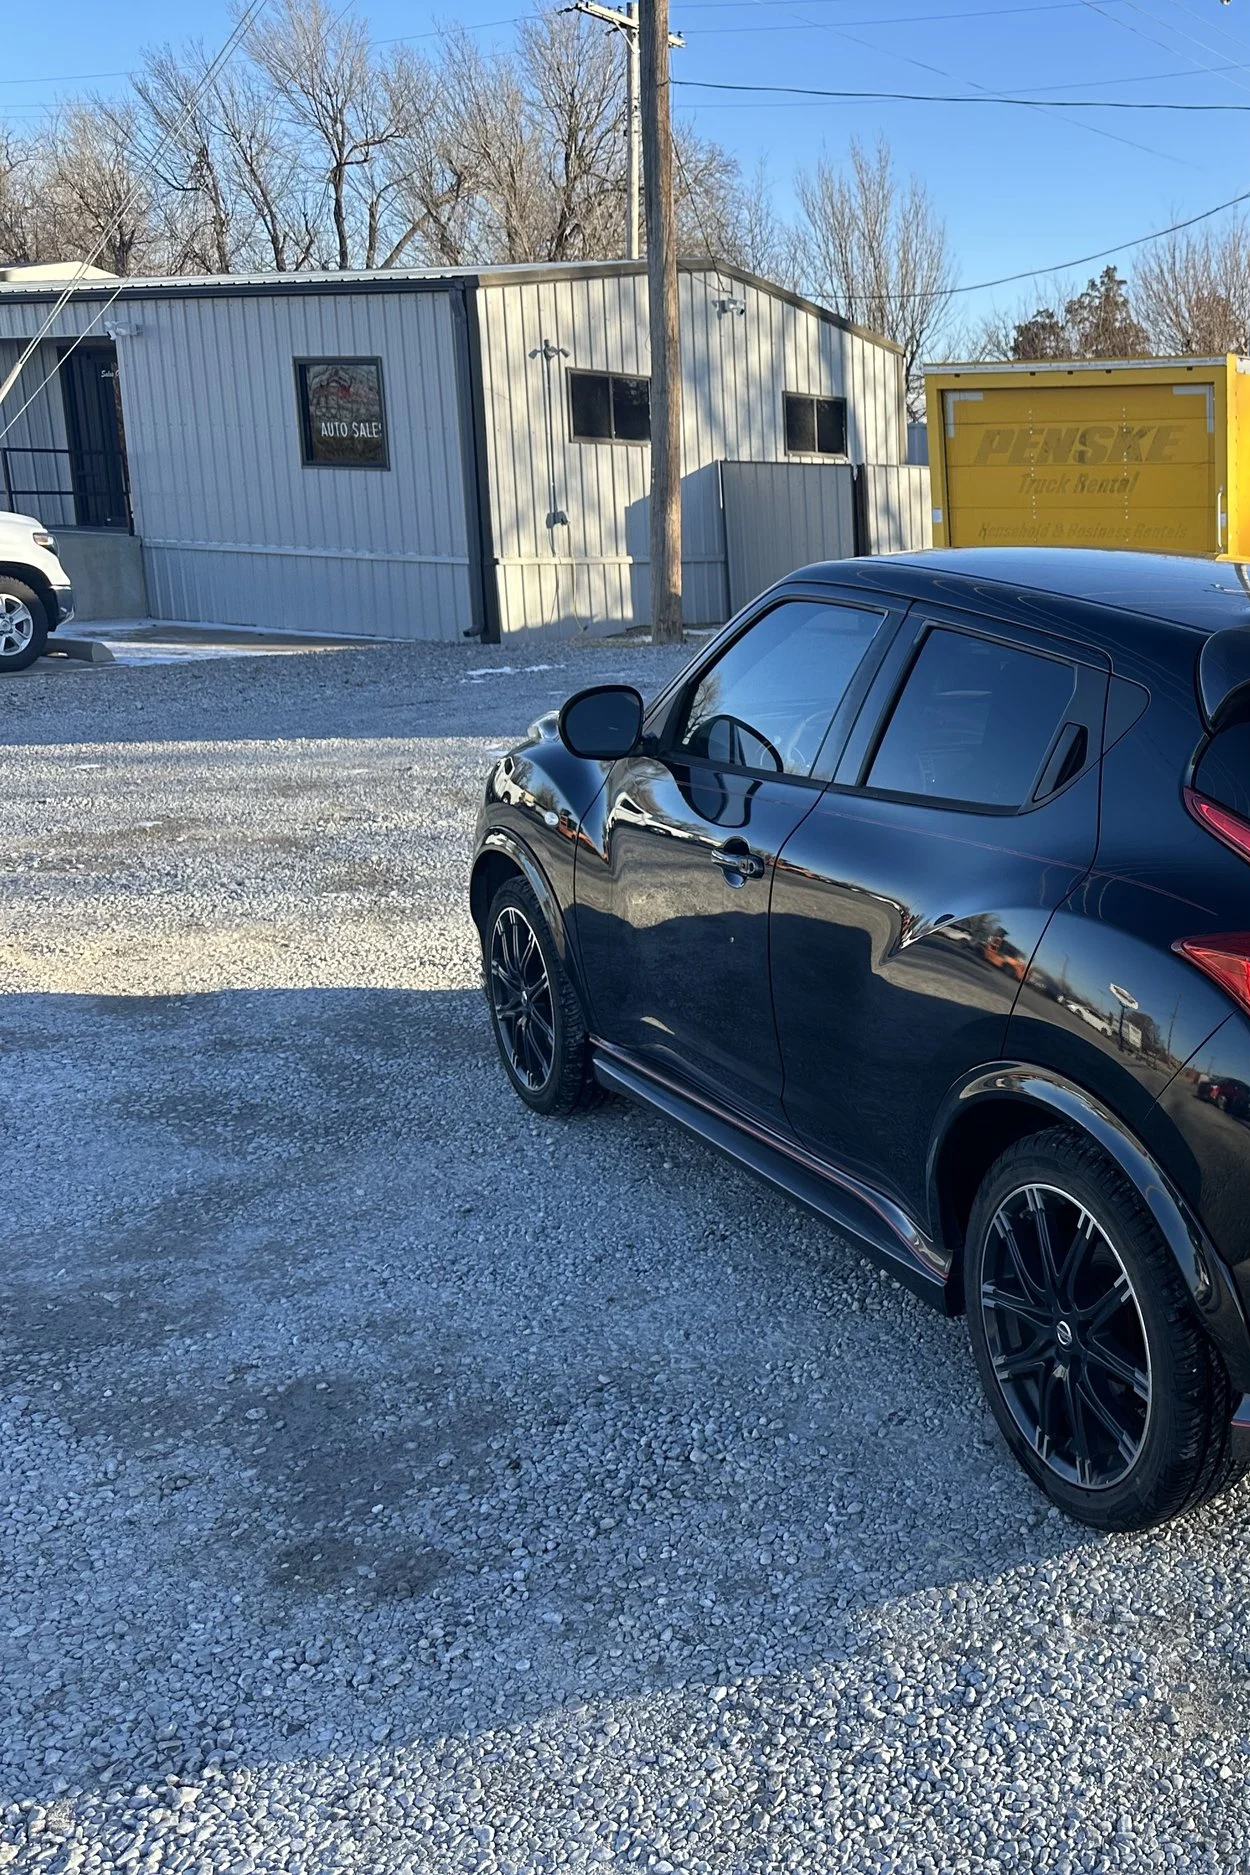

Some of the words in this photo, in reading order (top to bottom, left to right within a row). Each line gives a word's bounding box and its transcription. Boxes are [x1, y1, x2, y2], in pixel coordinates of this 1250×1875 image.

[321, 421, 348, 438] AUTO
[974, 425, 1186, 465] PENSKE
[1018, 473, 1071, 495] Truck
[1073, 471, 1140, 494] Rental
[1067, 522, 1132, 539] Business
[1133, 522, 1188, 539] Rentals
